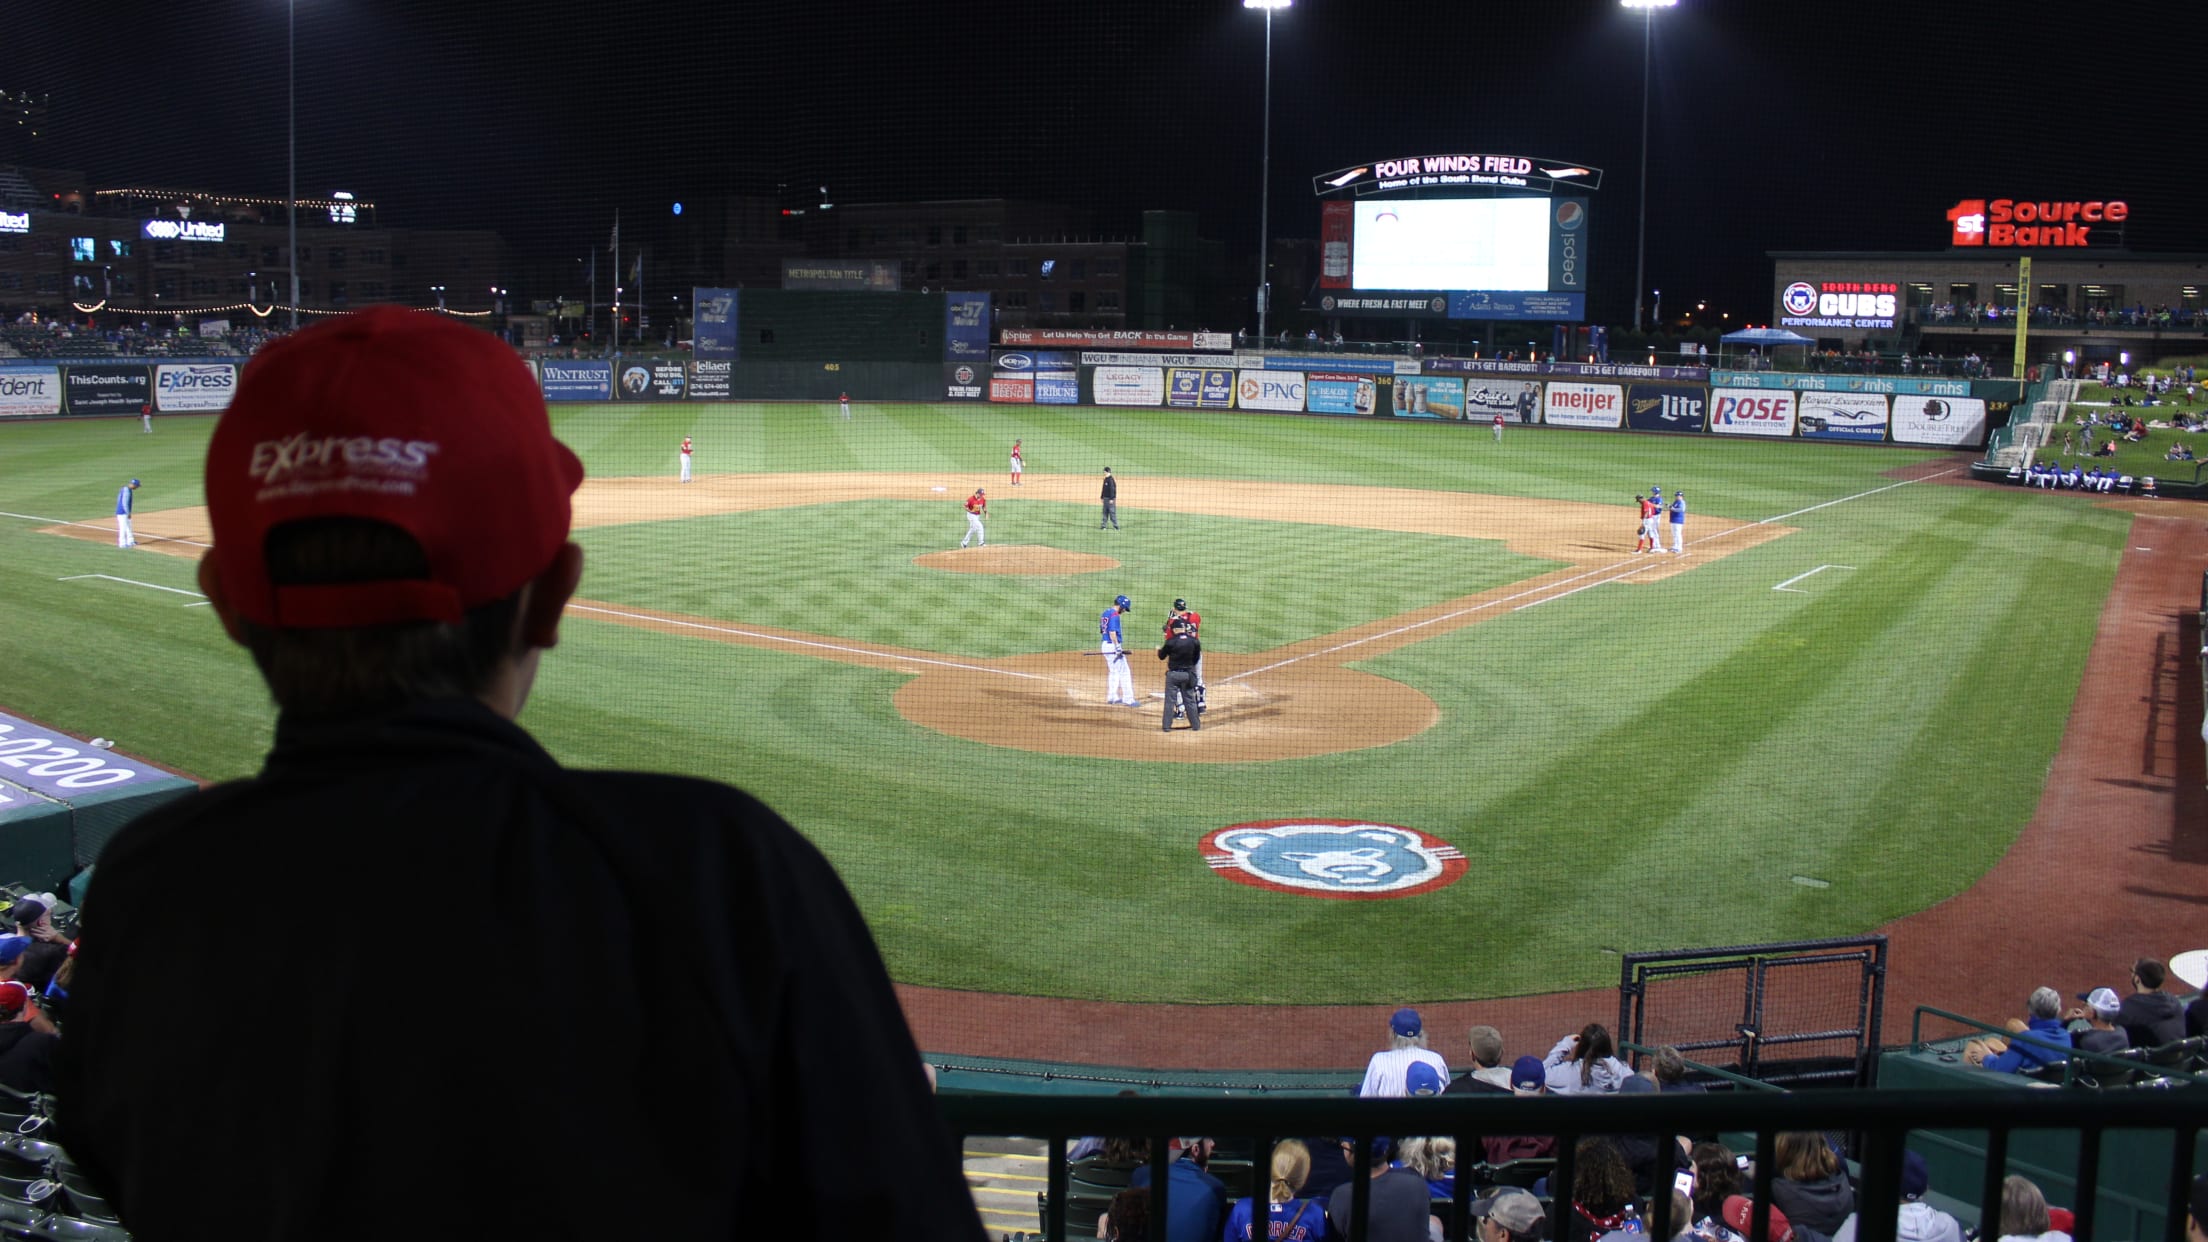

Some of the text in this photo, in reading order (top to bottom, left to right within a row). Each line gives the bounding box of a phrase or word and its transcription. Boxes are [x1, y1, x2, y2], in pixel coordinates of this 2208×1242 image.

[1375, 156, 1532, 178] FOUR WINDS FIELD
[1378, 175, 1527, 189] Home of the South Bend Cubs
[180, 221, 224, 238] United
[1946, 199, 2128, 246] 1st Source
[1989, 223, 2091, 246] Bank
[1562, 233, 1577, 285] pepsi
[788, 268, 864, 279] METROPOLITAN TITLE
[1821, 283, 1897, 293] SOUTH BEND
[711, 297, 733, 314] 57
[963, 301, 985, 318] 57
[1337, 299, 1361, 309] WHERE
[1361, 299, 1383, 309] FRESH
[1391, 300, 1408, 309] FAST
[1408, 300, 1429, 310] MEET
[1819, 293, 1896, 317] CUBS
[1781, 318, 1893, 329] PERFORMANCE CENTER
[1066, 332, 1082, 340] Help
[1113, 330, 1142, 339] BACK
[1167, 333, 1188, 341] Game
[1084, 354, 1108, 362] WGU
[1162, 356, 1185, 364] WGU
[544, 367, 609, 380] WINTRUST
[1463, 361, 1481, 370] LET'S
[1483, 363, 1496, 371] GET
[1498, 362, 1538, 373] BAREFOOT!
[1580, 365, 1600, 375] LET'S
[1601, 367, 1616, 375] GET
[1617, 367, 1660, 377] BAREFOOT!
[159, 371, 232, 392] Express
[1176, 371, 1200, 380] Ridge
[1732, 374, 1760, 387] mhs
[1797, 376, 1826, 390] mhs
[1864, 378, 1894, 392] mhs
[1934, 381, 1964, 395] mhs
[999, 390, 1023, 399] BEND
[1037, 387, 1078, 398] TRIBUNE
[1263, 382, 1303, 400] PNC
[1552, 387, 1615, 414] meijer
[1660, 394, 1702, 422] Lite
[1713, 397, 1789, 425] ROSE
[249, 432, 438, 484] Express
